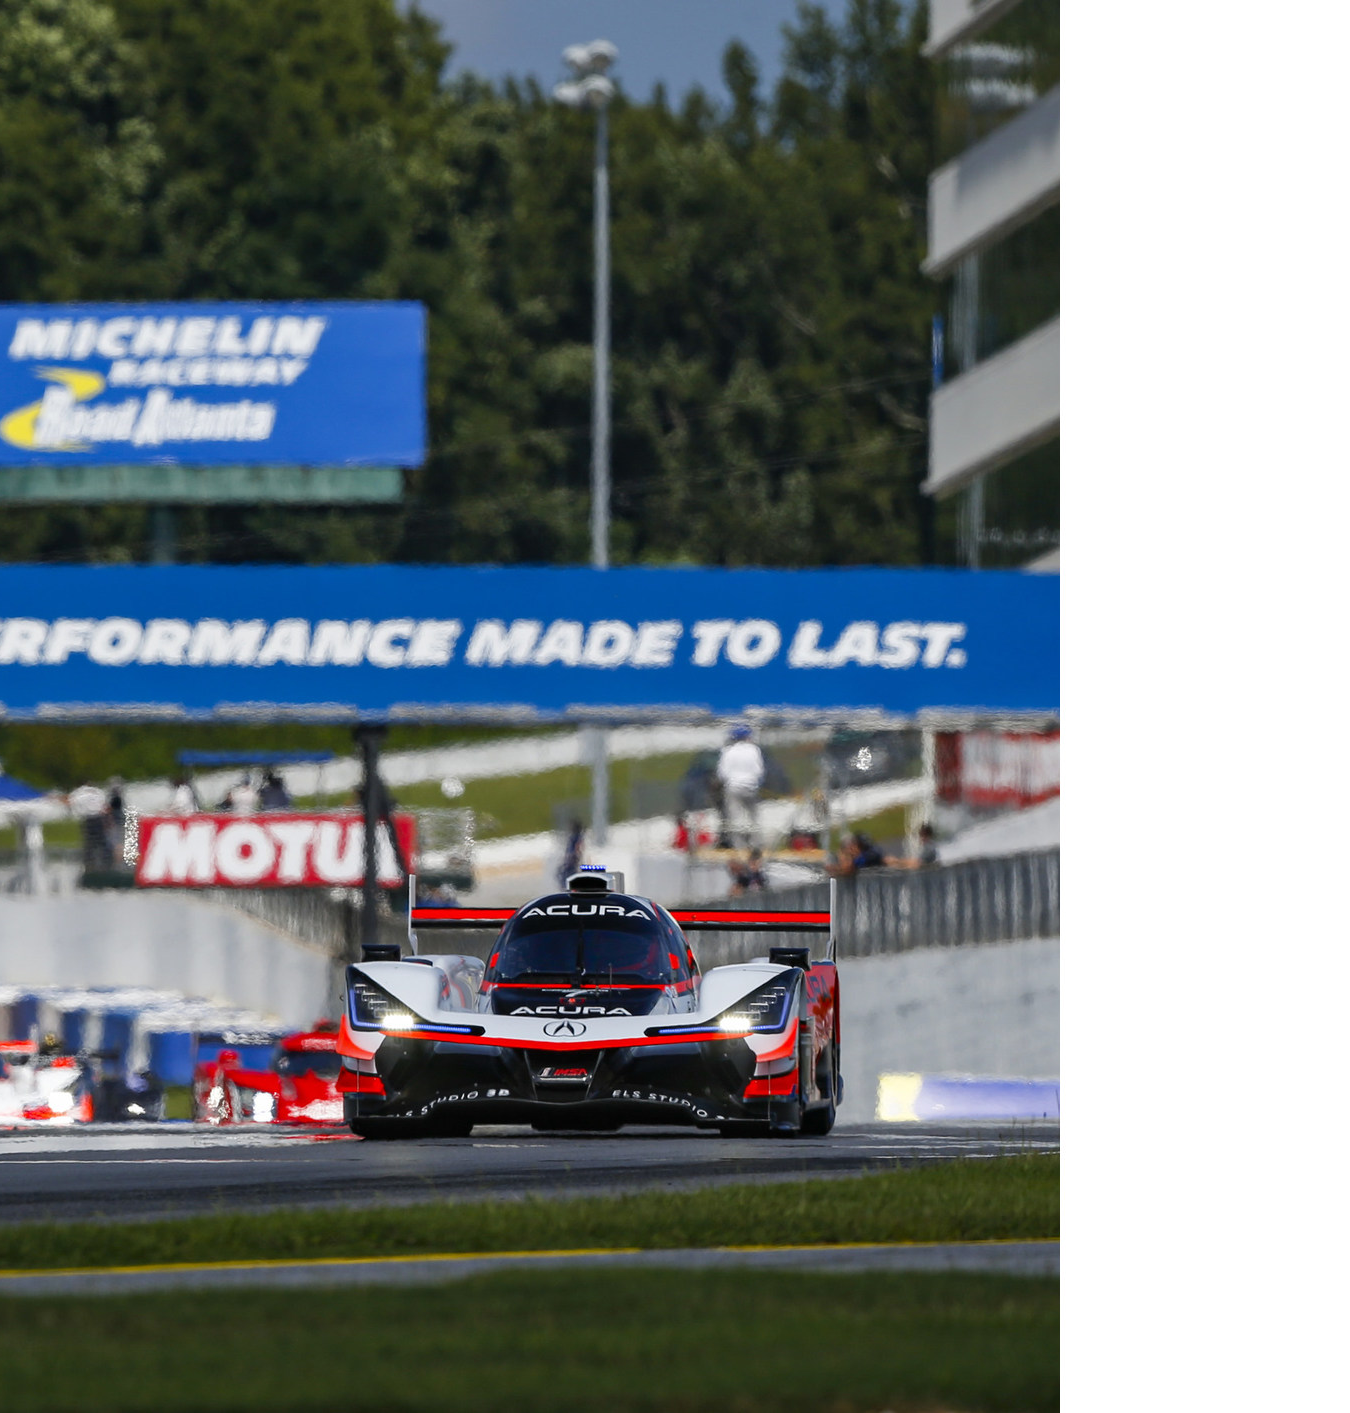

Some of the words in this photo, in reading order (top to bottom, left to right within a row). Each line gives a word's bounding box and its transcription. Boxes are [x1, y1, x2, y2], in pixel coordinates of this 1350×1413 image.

[9, 316, 327, 361] MICHELIN
[107, 357, 310, 387] RACEWAY
[465, 618, 684, 669] MADE
[691, 618, 781, 669] TO
[787, 619, 968, 669] LAST.
[522, 904, 651, 920] ACURA
[510, 1006, 632, 1015] ACURA
[421, 1090, 479, 1116] STUDIO
[612, 1089, 641, 1098] ELS
[648, 1093, 708, 1118] STUDIO
